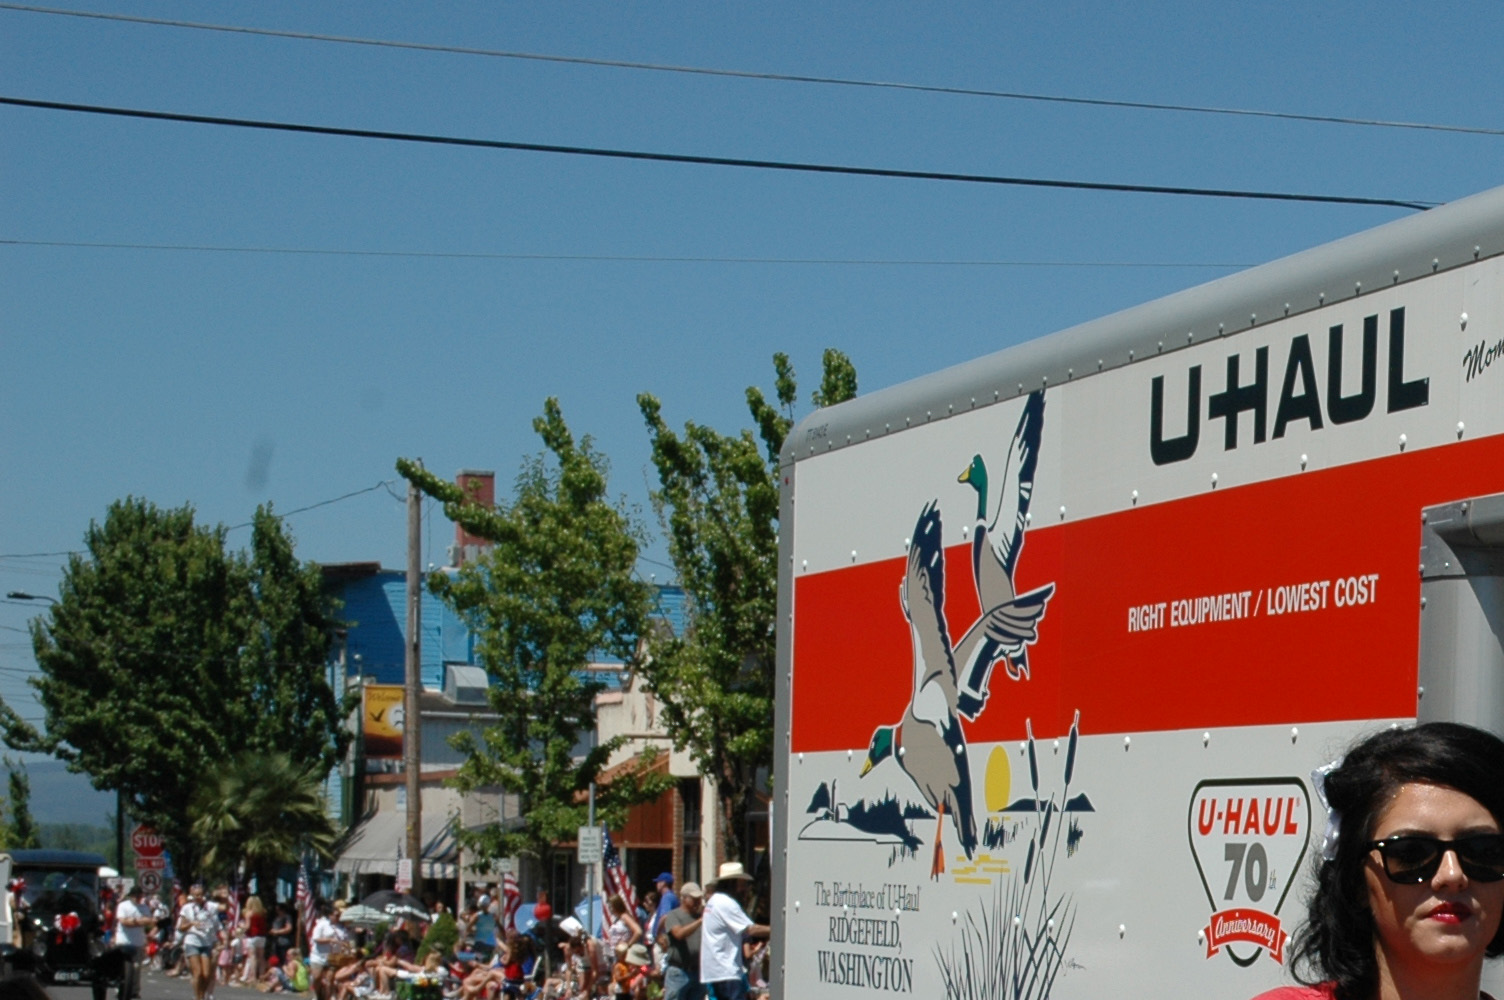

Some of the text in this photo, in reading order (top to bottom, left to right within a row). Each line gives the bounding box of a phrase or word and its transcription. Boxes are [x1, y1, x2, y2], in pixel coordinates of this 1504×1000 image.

[1150, 306, 1430, 467] U-HAUL
[1127, 602, 1167, 633] RIGHT
[1170, 590, 1252, 628] EQUIPMENT
[1266, 580, 1330, 616] LOWEST
[1334, 573, 1379, 607] COST
[1198, 797, 1298, 836] U-HAUL
[814, 881, 921, 916] The Birthplace of U-Haul
[828, 916, 902, 955] RIDGEFIELD,
[1215, 912, 1276, 947] Anniversary
[818, 950, 913, 994] WASHINGTON
